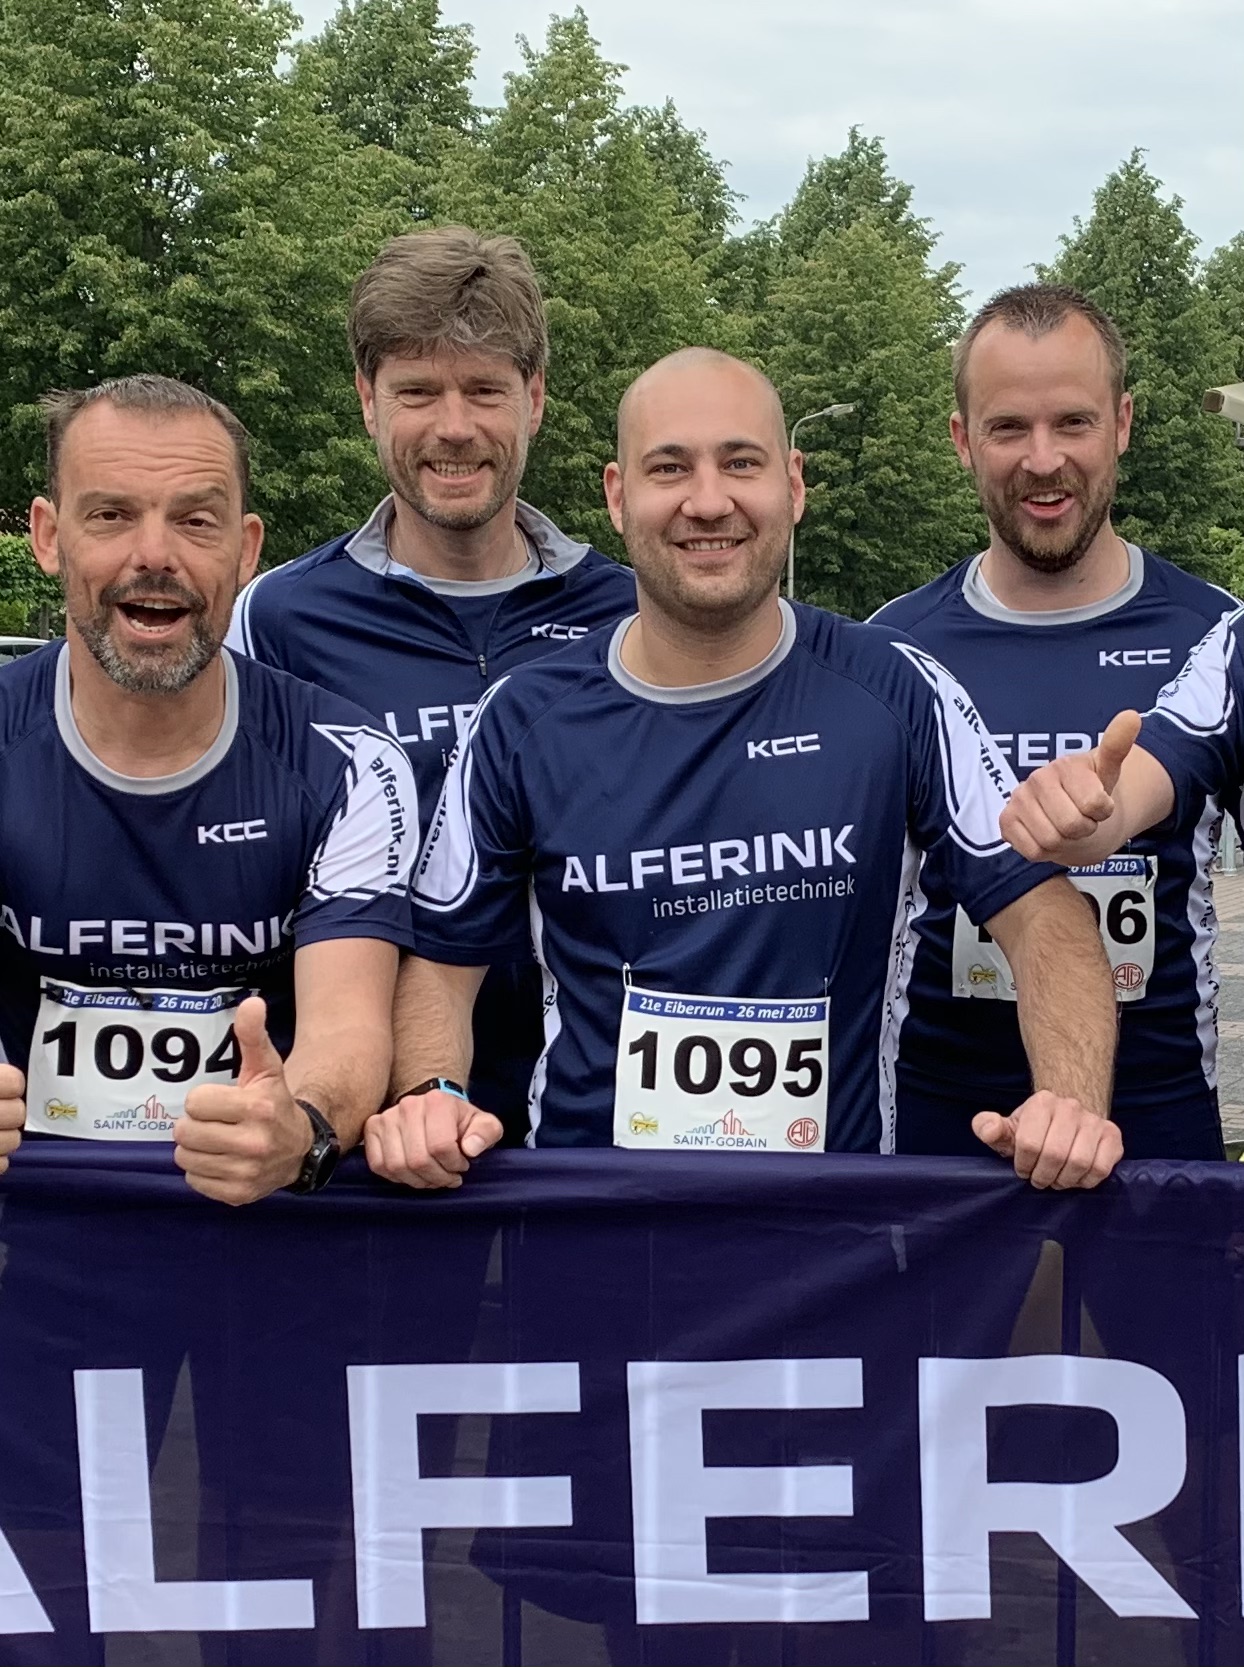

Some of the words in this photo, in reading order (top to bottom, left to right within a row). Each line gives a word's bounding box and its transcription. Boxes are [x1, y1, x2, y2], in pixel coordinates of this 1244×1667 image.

[531, 623, 589, 640] KCC
[1099, 648, 1171, 667] KCC
[747, 734, 821, 760] KCC
[370, 757, 406, 876] alferink.nl
[197, 819, 268, 844] KCC
[562, 825, 857, 893] ALFERINK
[1107, 860, 1138, 873] 2019
[653, 874, 856, 919] installatietechniek
[158, 996, 178, 1009] 26
[180, 998, 209, 1010] mei
[639, 997, 661, 1012] 21e
[664, 1001, 725, 1017] Eiberrun
[736, 1005, 755, 1018] 26
[757, 1007, 785, 1019] mei
[786, 1006, 818, 1019] 2019
[42, 1021, 243, 1083] 1094
[628, 1030, 823, 1098] 1095
[93, 1119, 176, 1132] SAINT-GOBA
[673, 1134, 767, 1149] SAINT-GOBAIN
[0, 1354, 1244, 1634] LFER
